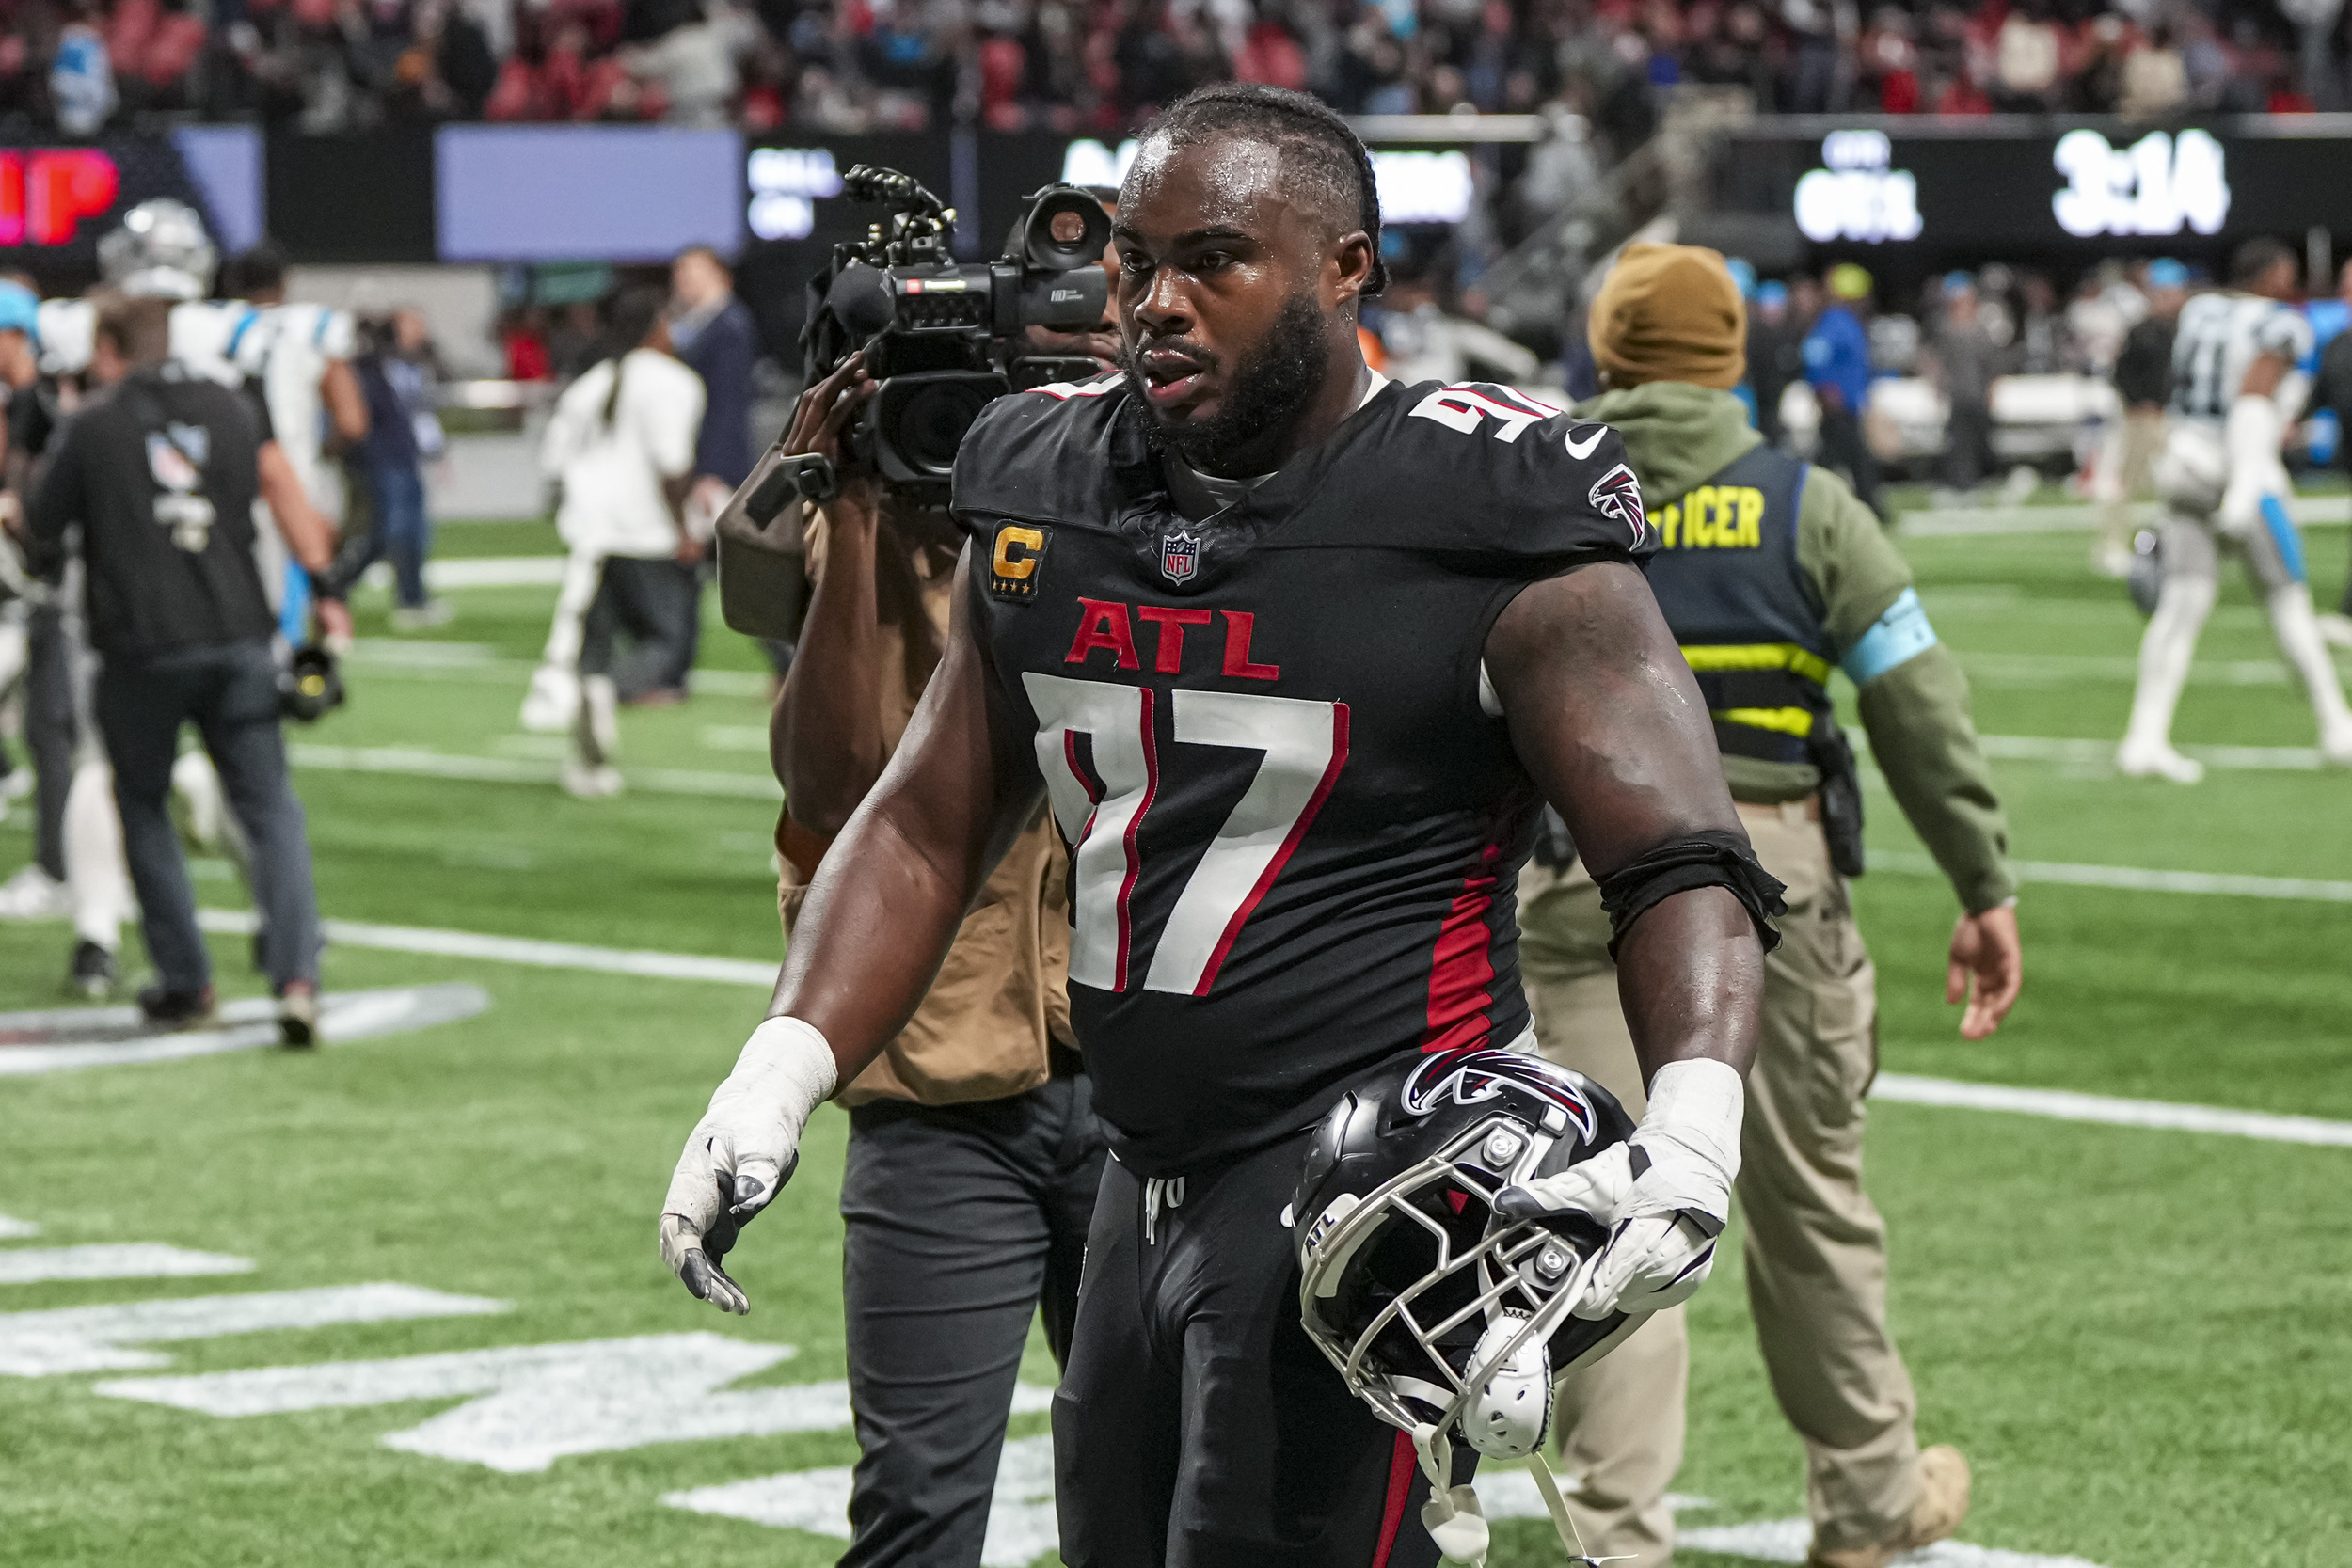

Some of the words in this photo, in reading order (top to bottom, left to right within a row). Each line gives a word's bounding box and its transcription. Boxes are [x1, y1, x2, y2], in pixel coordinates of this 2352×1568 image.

[993, 525, 1043, 579] C
[1167, 554, 1191, 575] NFL
[1064, 596, 1279, 681] ATL
[1022, 672, 1350, 997] 97
[1305, 1213, 1335, 1257] ATL
